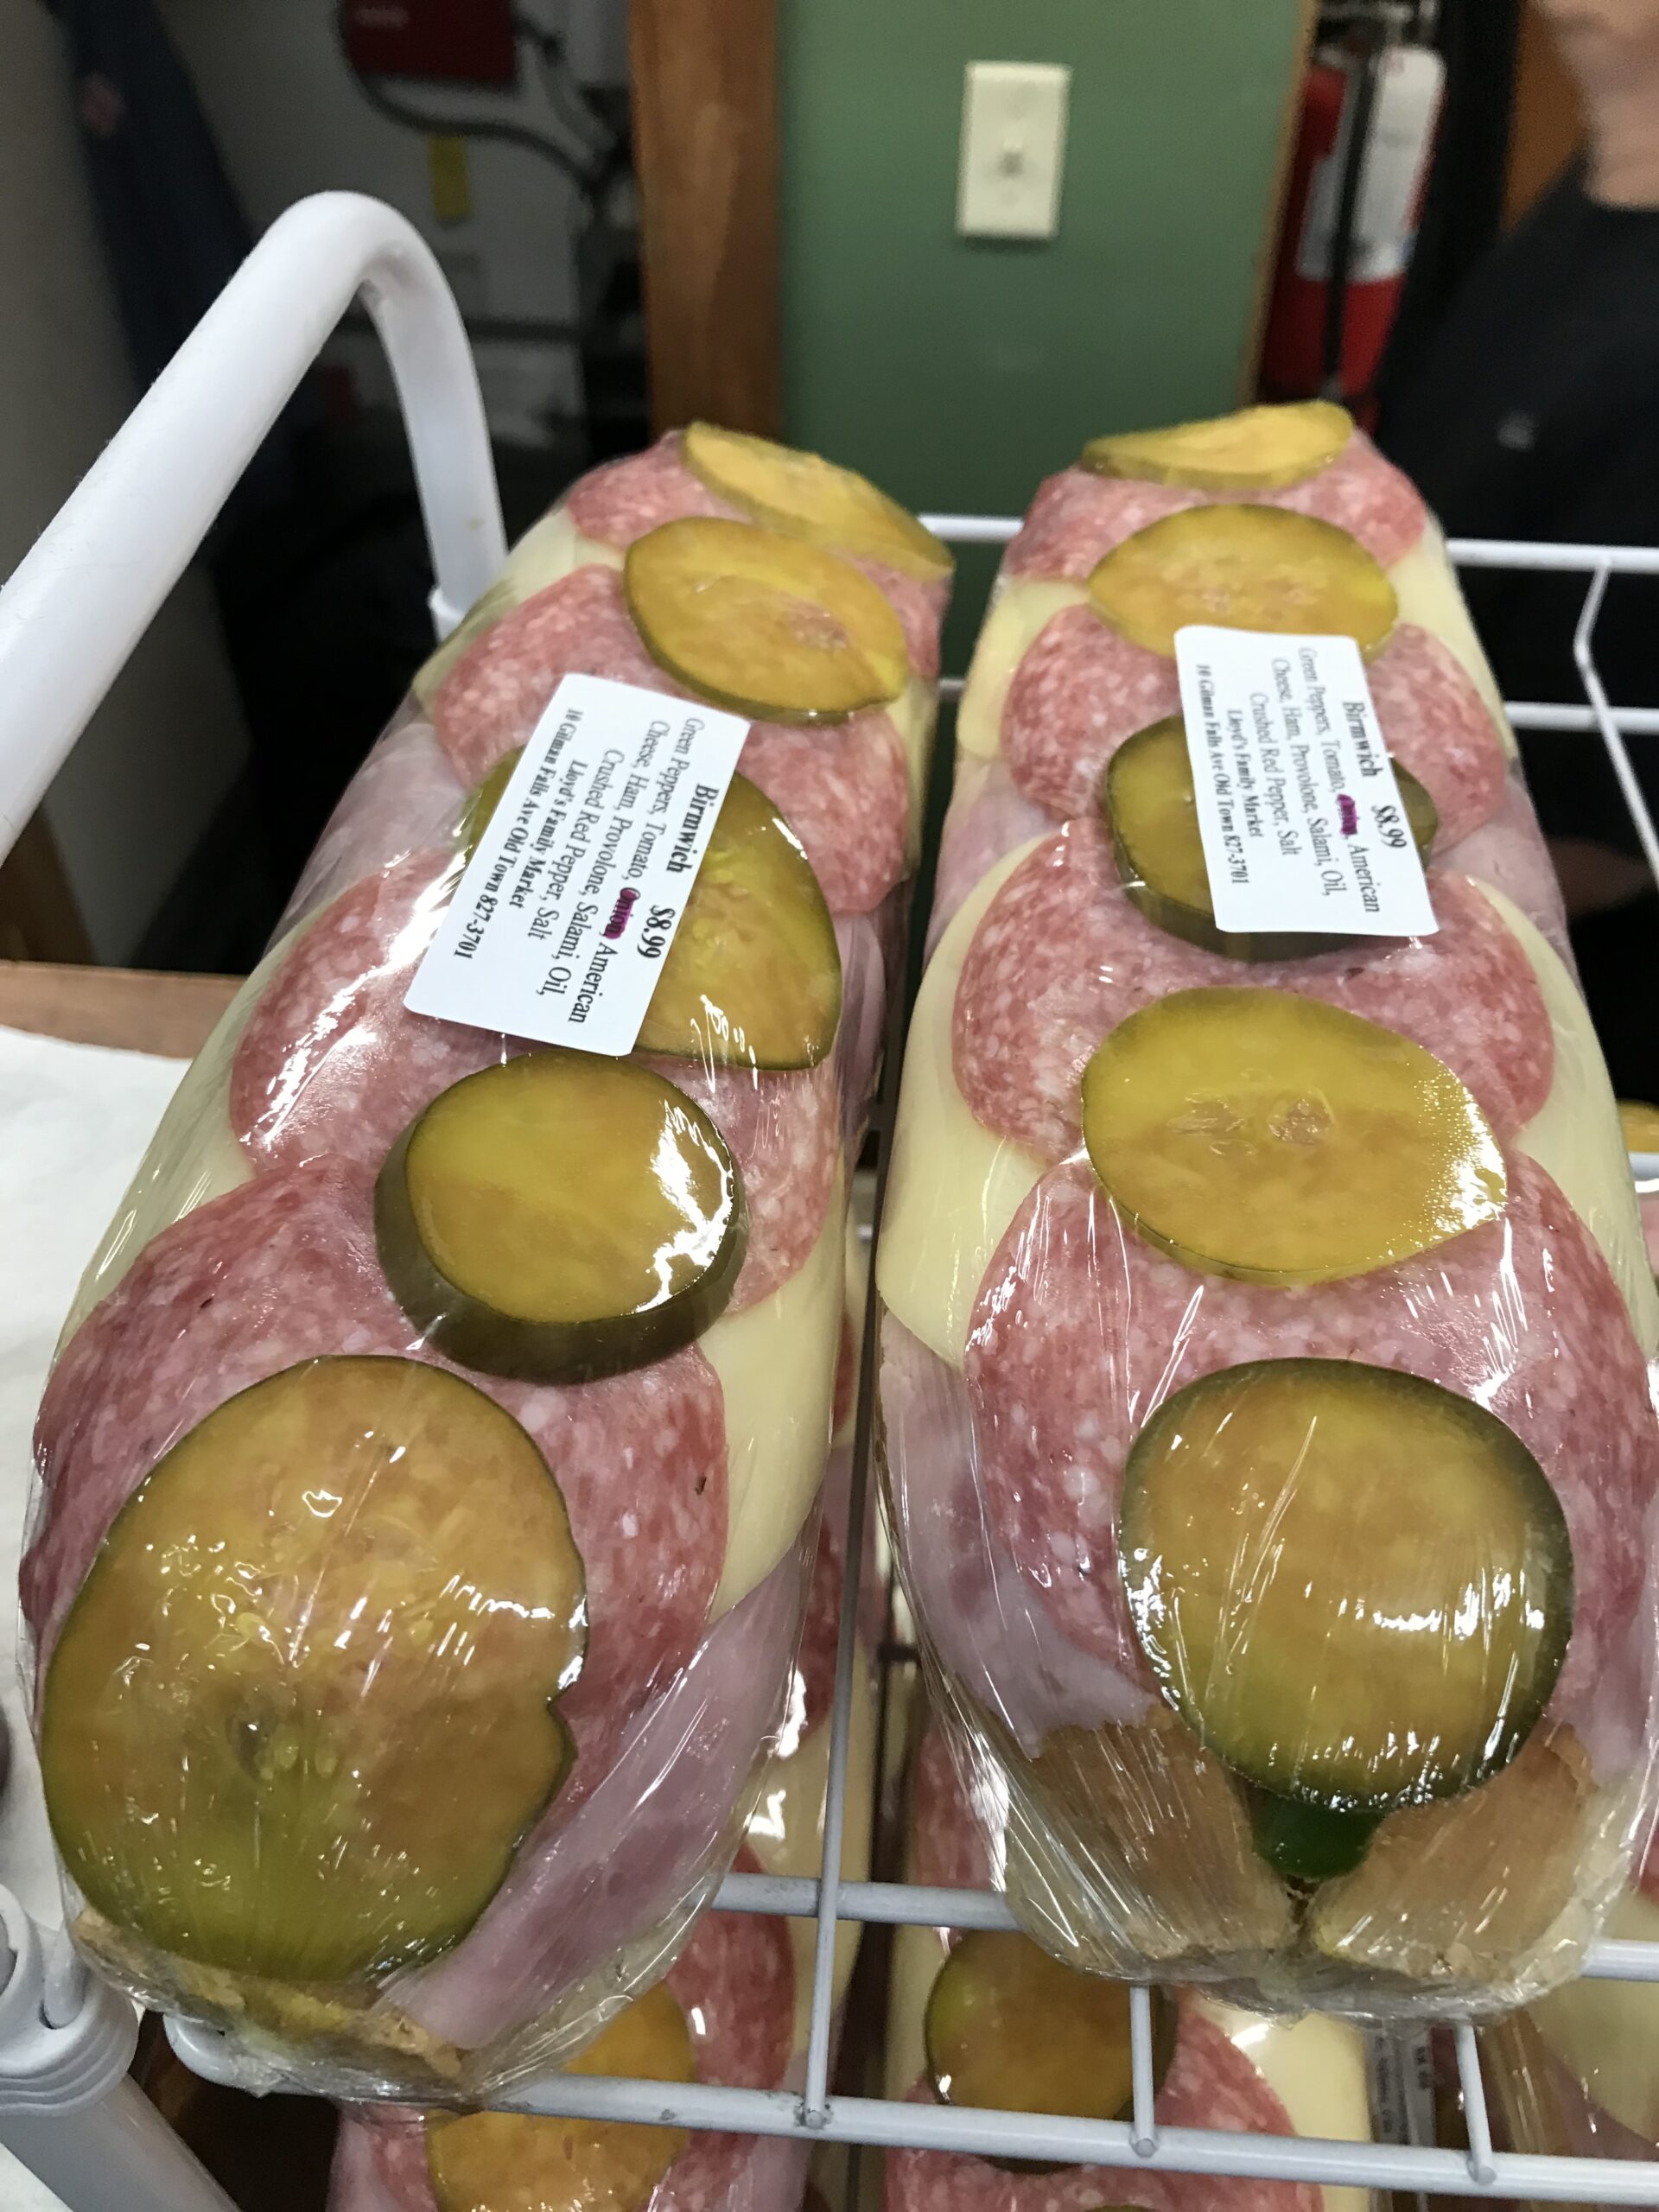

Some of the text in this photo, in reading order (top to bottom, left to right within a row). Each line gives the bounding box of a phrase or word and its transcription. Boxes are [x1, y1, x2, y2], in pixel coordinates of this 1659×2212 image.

[1271, 658, 1294, 703] Cheese,
[1298, 647, 1319, 683] Green
[1198, 678, 1215, 719] Gilman
[1306, 685, 1332, 736] Peppers,
[543, 722, 577, 765] Gilman
[673, 717, 705, 755] Green
[1205, 721, 1223, 748] Falls
[1281, 706, 1303, 741] Ham,
[529, 765, 557, 797] Falls
[646, 756, 690, 816] Peppers,
[1209, 751, 1224, 772] Ave
[1213, 772, 1232, 796] Old
[1226, 709, 1264, 837] Lloyd's Family Market
[1249, 692, 1303, 856] Crushed Red Pepper, Salt
[1289, 744, 1319, 814] Provolone,
[1320, 739, 1346, 793] Tomato,
[1342, 702, 1384, 778] Birmwich
[1370, 804, 1408, 849] $8.99
[508, 760, 588, 909] Lloyd's Family Market
[516, 797, 540, 825] Ave
[1217, 798, 1235, 832] Town
[503, 826, 529, 854] Old
[527, 748, 626, 941] Crushed Red Pepper, Salt
[536, 720, 671, 996] Cheese, Ham, Provolone, Salami, Oil,
[621, 822, 667, 880] Tomato,
[1223, 835, 1249, 884] 827-3701
[1306, 817, 1339, 867] Salami,
[484, 855, 518, 893] Town
[637, 783, 720, 959] Birmwich $8.99
[1320, 869, 1348, 897] Oil,
[1347, 844, 1381, 912] American
[454, 893, 499, 959] 827-3701
[567, 942, 619, 1024] American
